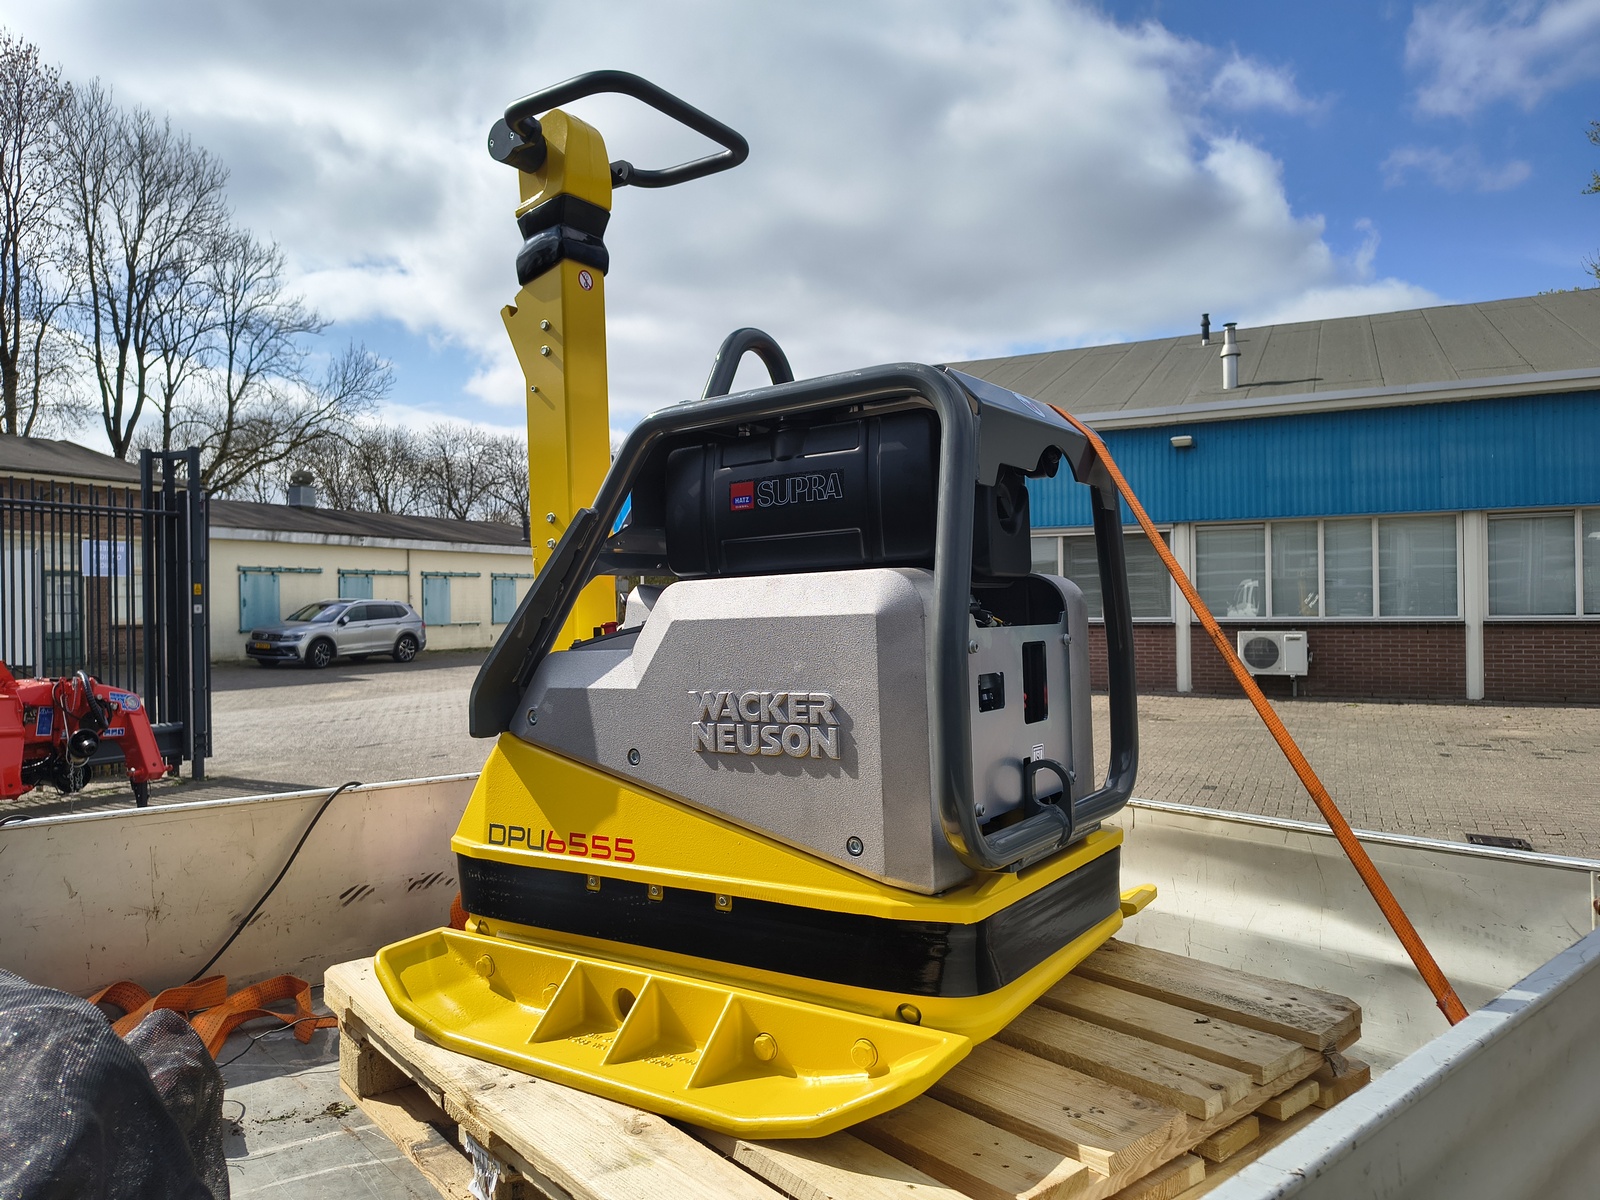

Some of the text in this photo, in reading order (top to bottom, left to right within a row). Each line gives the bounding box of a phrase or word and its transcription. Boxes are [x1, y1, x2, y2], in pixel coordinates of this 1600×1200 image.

[734, 496, 750, 504] HATZ
[757, 472, 843, 507] SUPRA
[687, 690, 840, 726] WACKER
[691, 721, 841, 760] NEUSON
[488, 823, 636, 862] DPU6555
